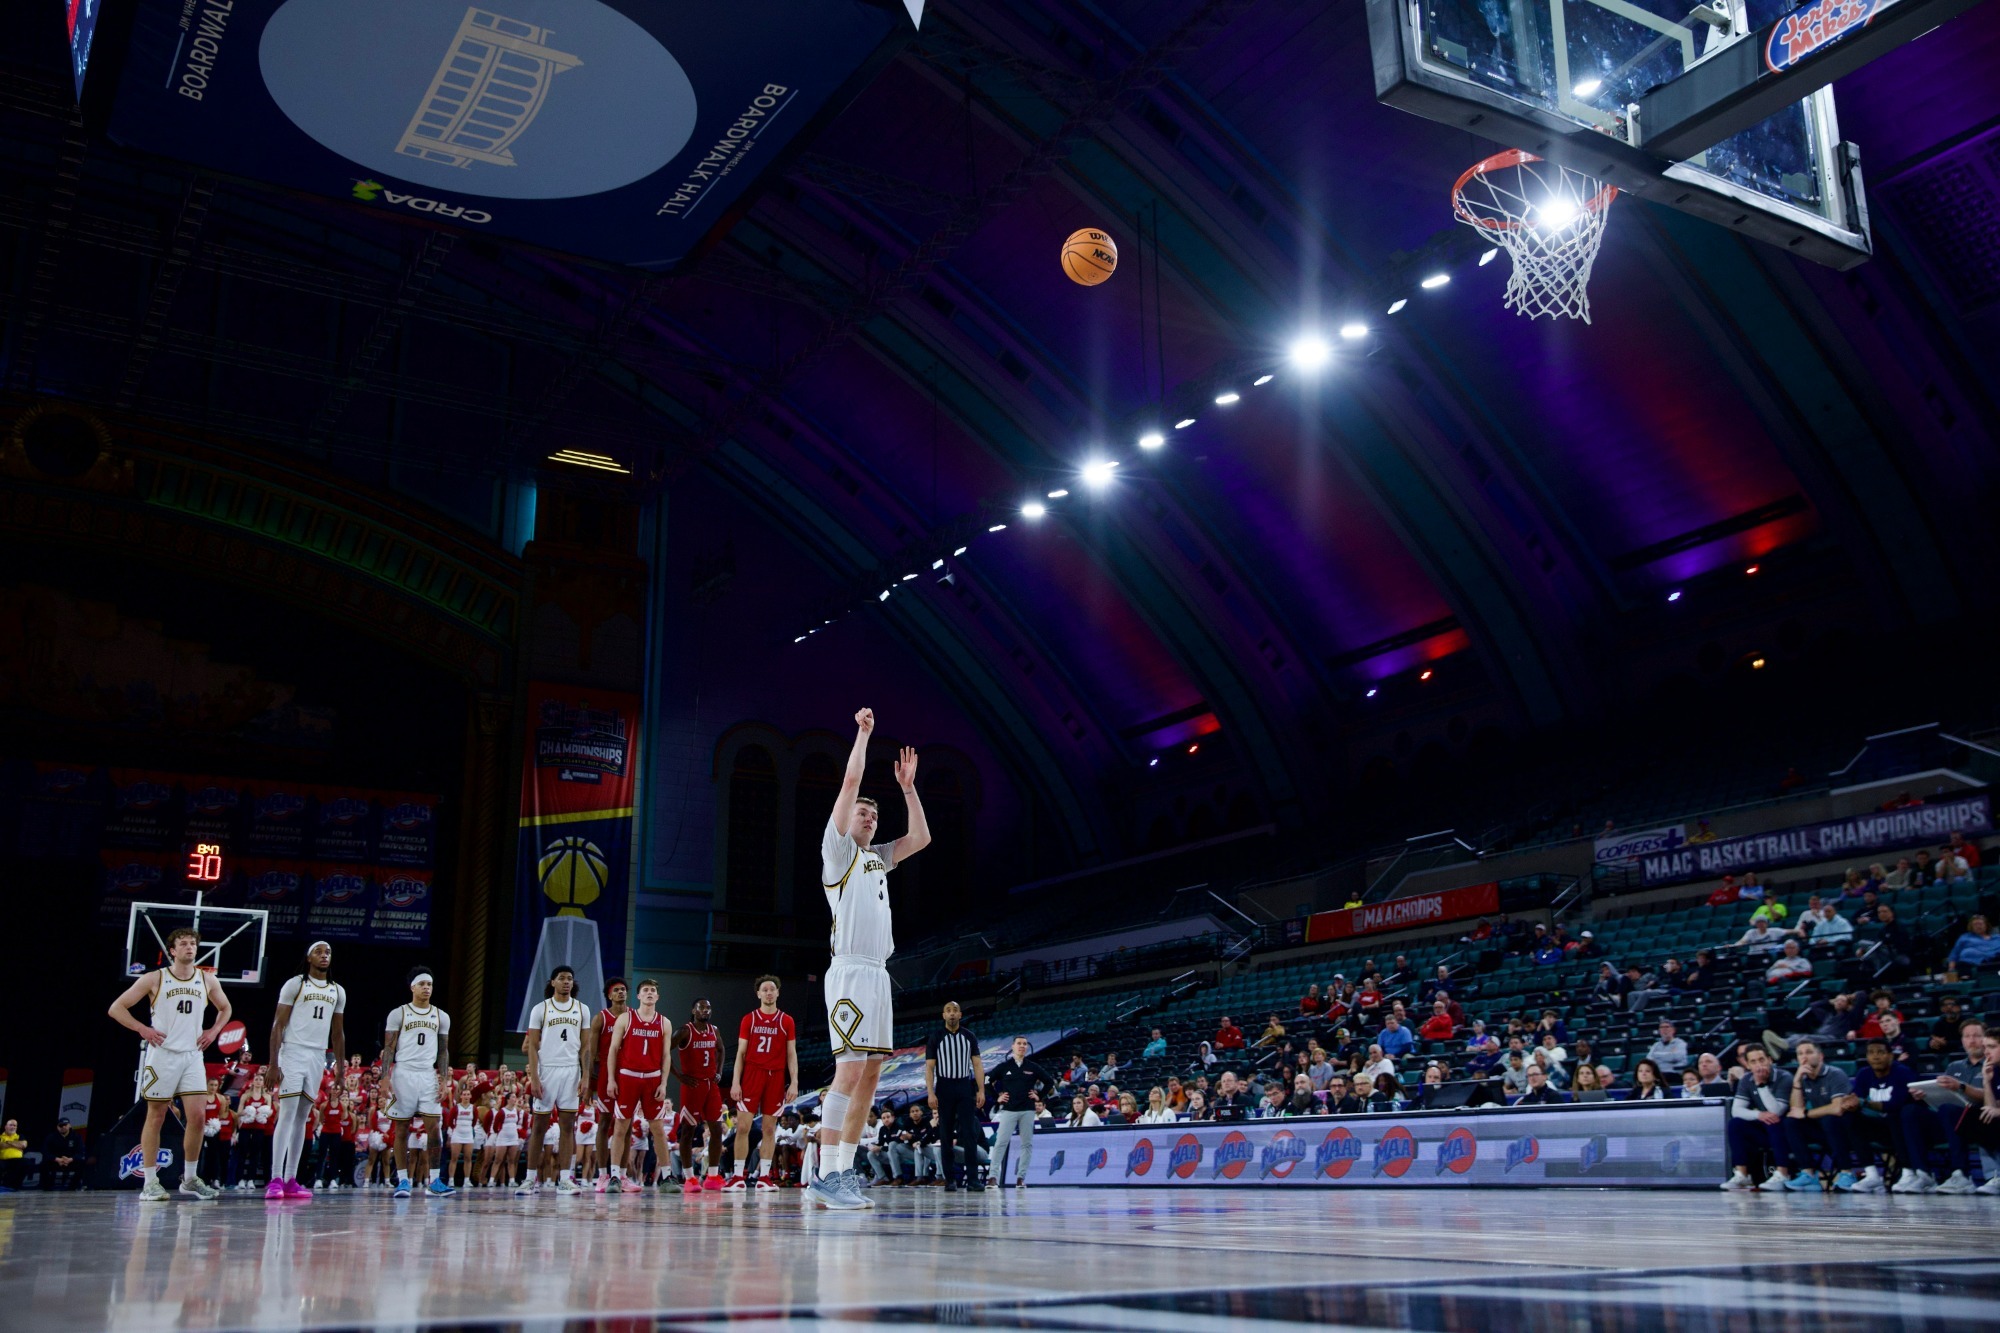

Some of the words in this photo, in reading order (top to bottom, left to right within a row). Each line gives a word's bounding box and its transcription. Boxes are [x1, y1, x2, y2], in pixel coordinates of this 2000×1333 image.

[1781, 0, 1857, 44] Jers
[688, 83, 788, 181] BOARDWALK
[384, 189, 492, 223] CRDA
[656, 182, 701, 216] HALL
[1092, 248, 1115, 265] NCAA
[540, 740, 622, 765] CHAMPIONSHIPS
[1597, 837, 1661, 860] COPIERS
[1645, 851, 1693, 880] MAAC
[1700, 832, 1812, 870] BASKETBALL
[1820, 801, 1986, 850] CHAMPIONSHIPS
[188, 853, 221, 880] 30
[381, 880, 427, 902] MAAC
[309, 905, 367, 917] QUINNIPIAC
[373, 909, 428, 922] QUINNIPIAC
[307, 914, 365, 927] UNIVERSITY
[370, 918, 428, 931] UNIVERSITY
[166, 987, 202, 1000] MERRIMACK
[303, 993, 336, 1006] MERRIMACK
[177, 1000, 193, 1014] 40
[312, 1005, 324, 1020] 11
[405, 1020, 438, 1032] MERRIMACK
[548, 1017, 579, 1028] MERRIMACK
[218, 1027, 246, 1046] SHU
[417, 1032, 426, 1046] 0
[560, 1028, 568, 1041] 4
[642, 1039, 649, 1056] 1
[757, 1036, 772, 1053] 21
[703, 1050, 710, 1067] 3
